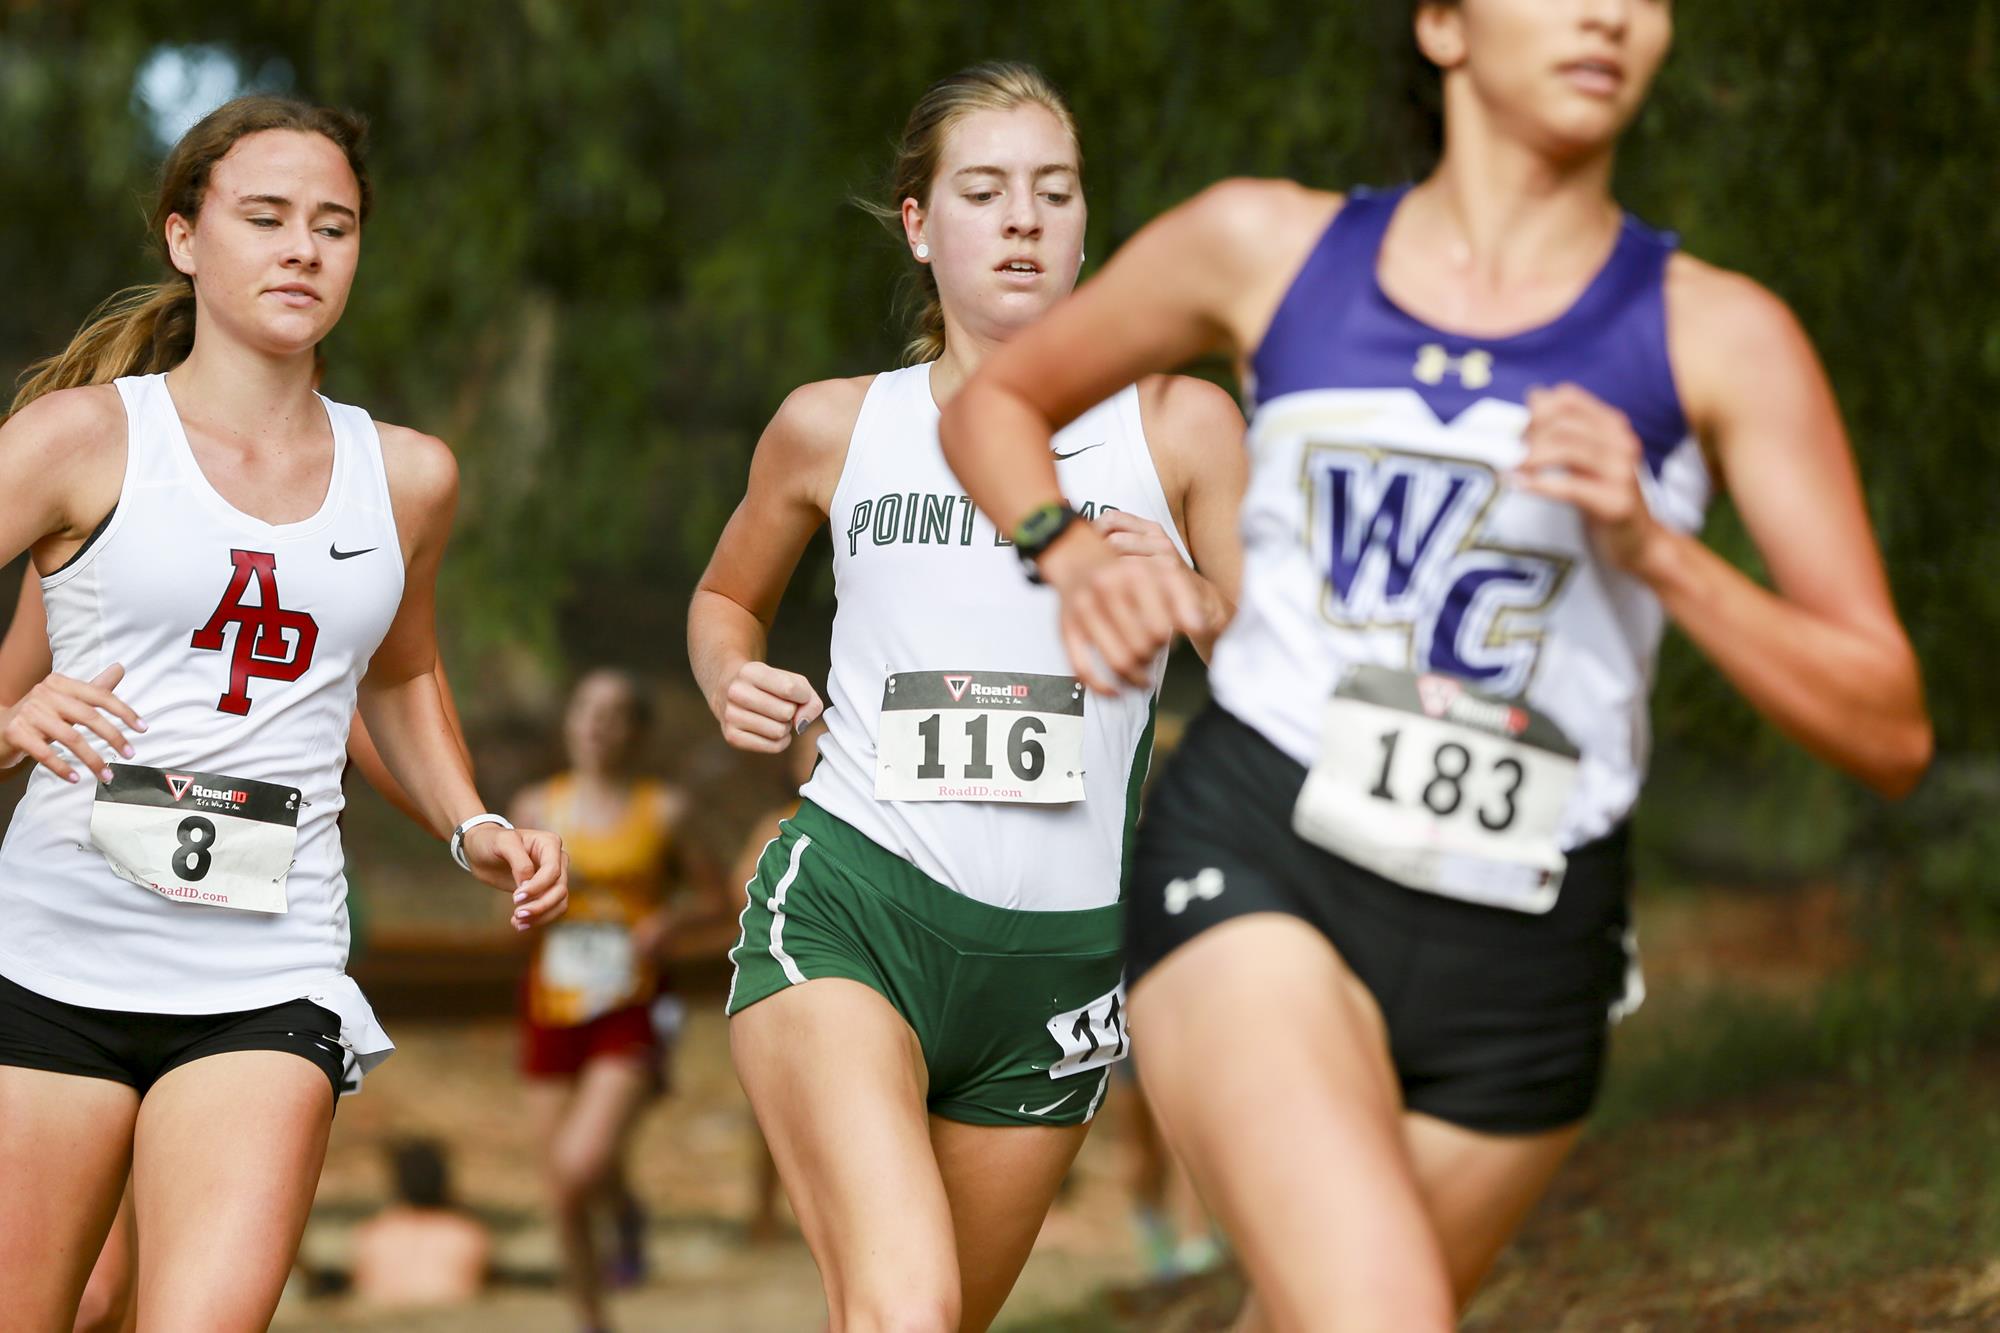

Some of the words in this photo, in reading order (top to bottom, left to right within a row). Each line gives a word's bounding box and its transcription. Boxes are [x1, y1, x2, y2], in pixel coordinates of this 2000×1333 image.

[848, 493, 977, 556] POINT
[190, 548, 319, 716] AP
[971, 683, 1028, 697] RoadID
[917, 714, 1047, 781] 116
[1369, 729, 1523, 831] 183
[191, 784, 248, 804] RoadID
[939, 786, 1022, 798] RoadID.com
[171, 815, 216, 882] 8
